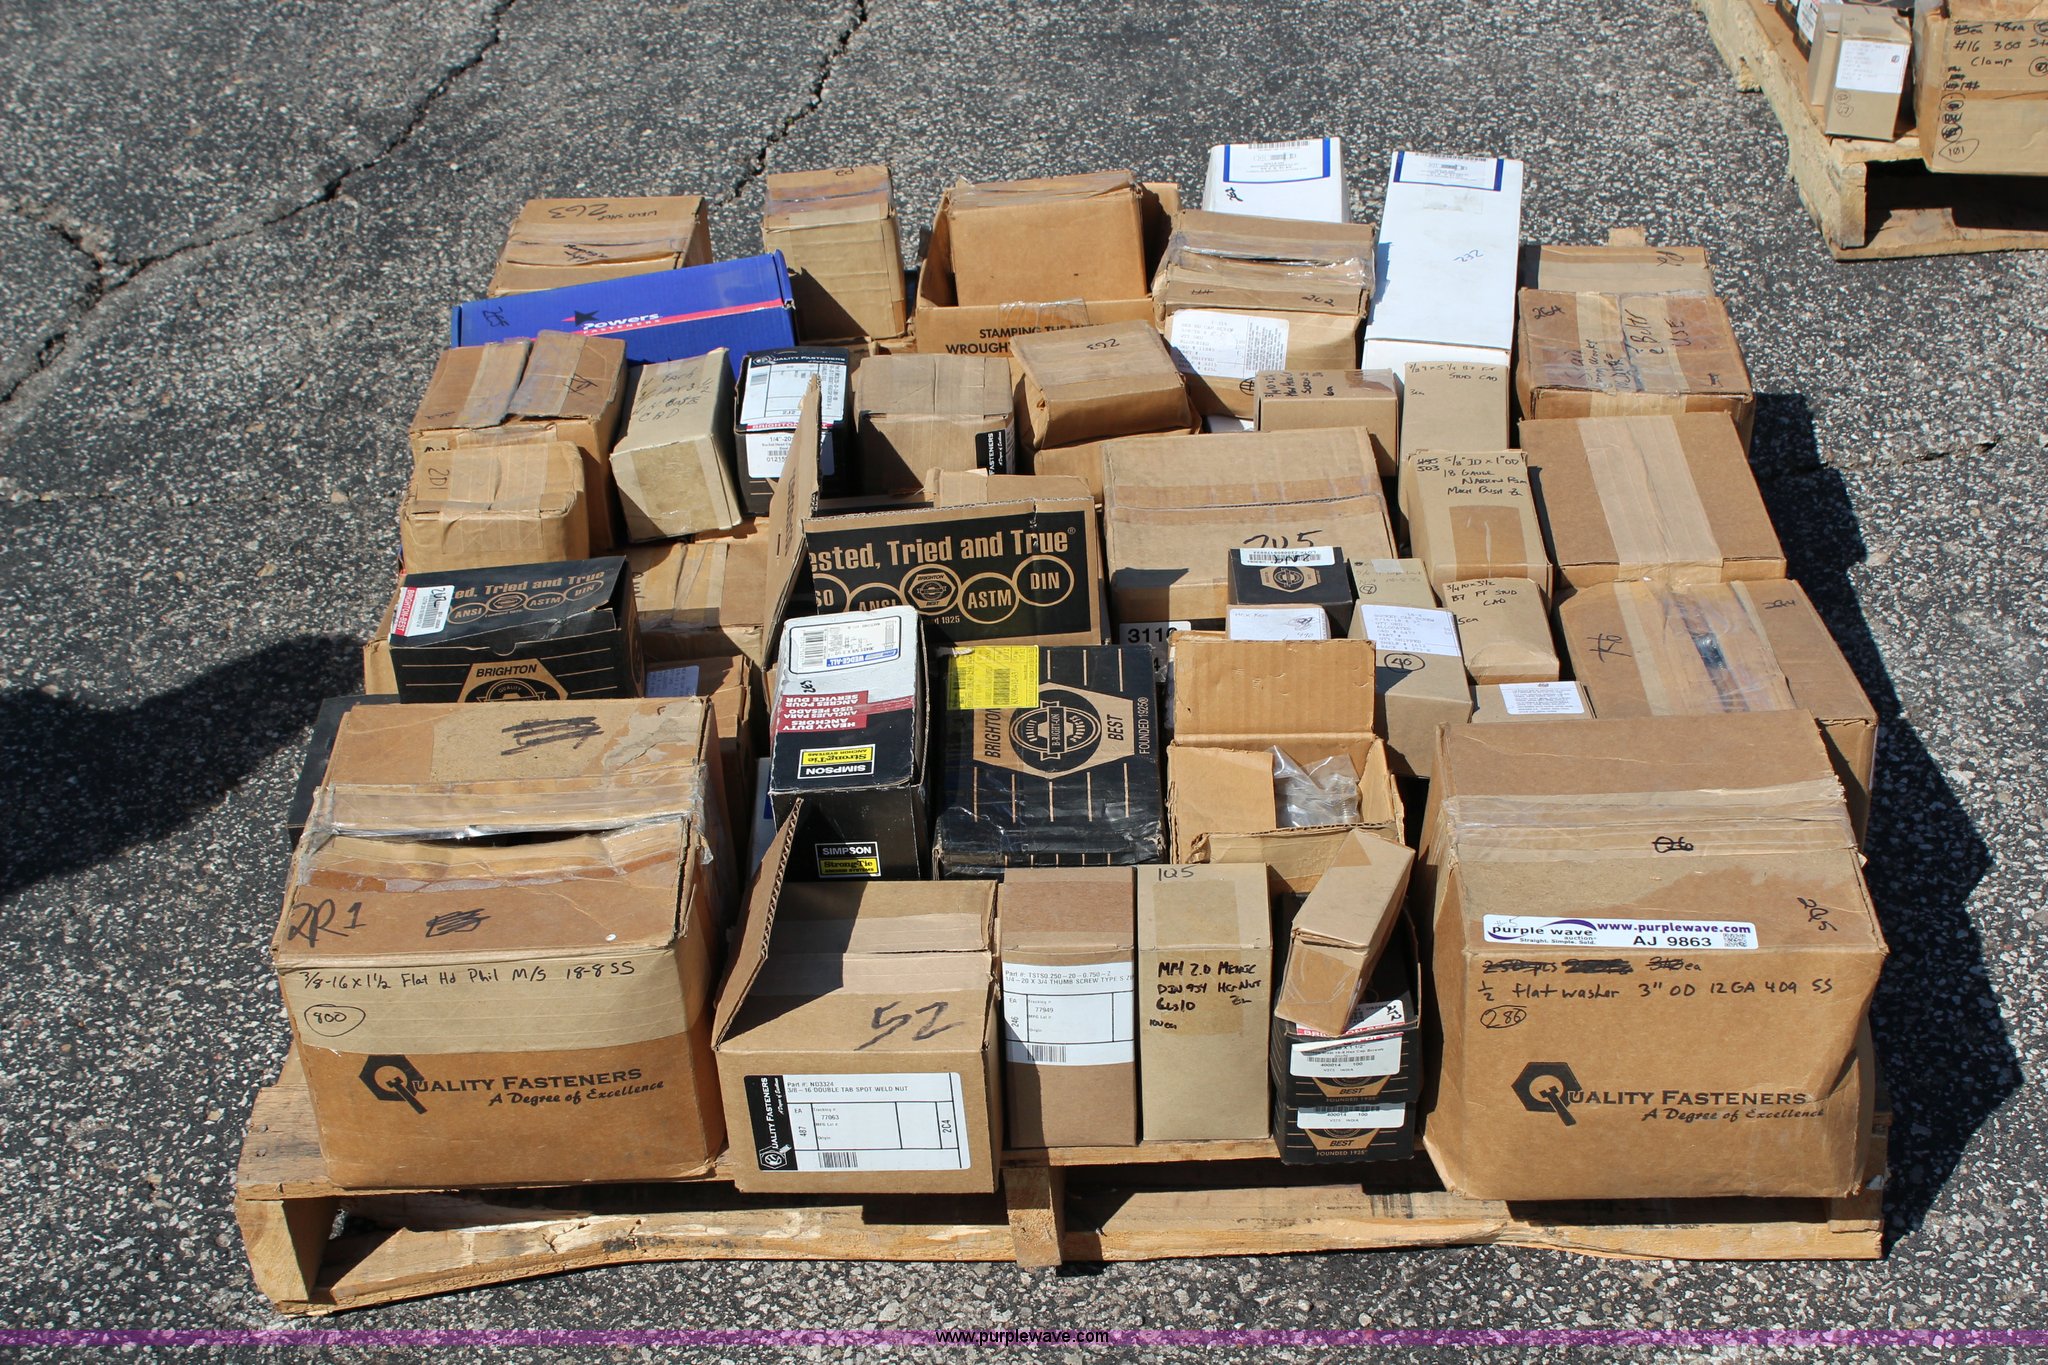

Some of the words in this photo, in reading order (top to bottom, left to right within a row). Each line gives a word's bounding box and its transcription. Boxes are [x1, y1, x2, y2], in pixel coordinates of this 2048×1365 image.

[1953, 40, 1980, 52] #16
[583, 313, 661, 331] Powers
[583, 319, 661, 334] FASTENERS
[945, 342, 1011, 354] WROUGH
[988, 432, 996, 476] FASTENERS
[809, 543, 882, 572] ested,
[886, 536, 953, 566] Tried
[961, 531, 1004, 561] and
[484, 581, 528, 595] Tried
[532, 577, 563, 589] and
[567, 571, 605, 585] True
[1029, 572, 1061, 590] DIN
[574, 585, 596, 597] DIN
[529, 596, 562, 607] ASTM
[967, 589, 1013, 609] ASTM
[397, 588, 416, 634] BRIGHTON-BEST
[454, 607, 483, 619] ANSI
[476, 664, 538, 678] BRIGHTON
[812, 694, 859, 702] SERVICE
[791, 718, 849, 726] ANCHORS
[811, 710, 858, 719] ANCLAJES
[1107, 714, 1124, 741] BEST
[1139, 719, 1151, 755] FOUNDED
[805, 764, 867, 775] SIMPSON
[822, 846, 872, 855] SIMPSON
[1492, 923, 1544, 937] purple
[1550, 928, 1593, 937] wave
[1597, 921, 1751, 935] www.purplewave.com
[1519, 937, 1550, 945] Straight.
[1551, 938, 1578, 946] Simple.
[1633, 936, 1658, 947] AJ
[1667, 936, 1712, 947] 9863
[402, 971, 428, 987] Flat
[439, 971, 457, 985] Hd
[469, 967, 499, 982] Phil
[610, 960, 636, 975] SS
[1512, 984, 1559, 998] flat
[1669, 983, 1696, 997] OD
[1812, 978, 1833, 993] SS
[503, 1067, 642, 1090] FASTENERS
[488, 1093, 503, 1107] A
[507, 1092, 561, 1108] Degree
[564, 1090, 581, 1105] of
[586, 1080, 665, 1100] Excellence
[760, 1077, 776, 1122] FASTENERS
[1662, 1090, 1808, 1105] FASTENERS
[1641, 1108, 1659, 1121] A
[1663, 1108, 1718, 1123] Degree
[1722, 1108, 1738, 1122] of
[942, 1119, 952, 1134] 2C4
